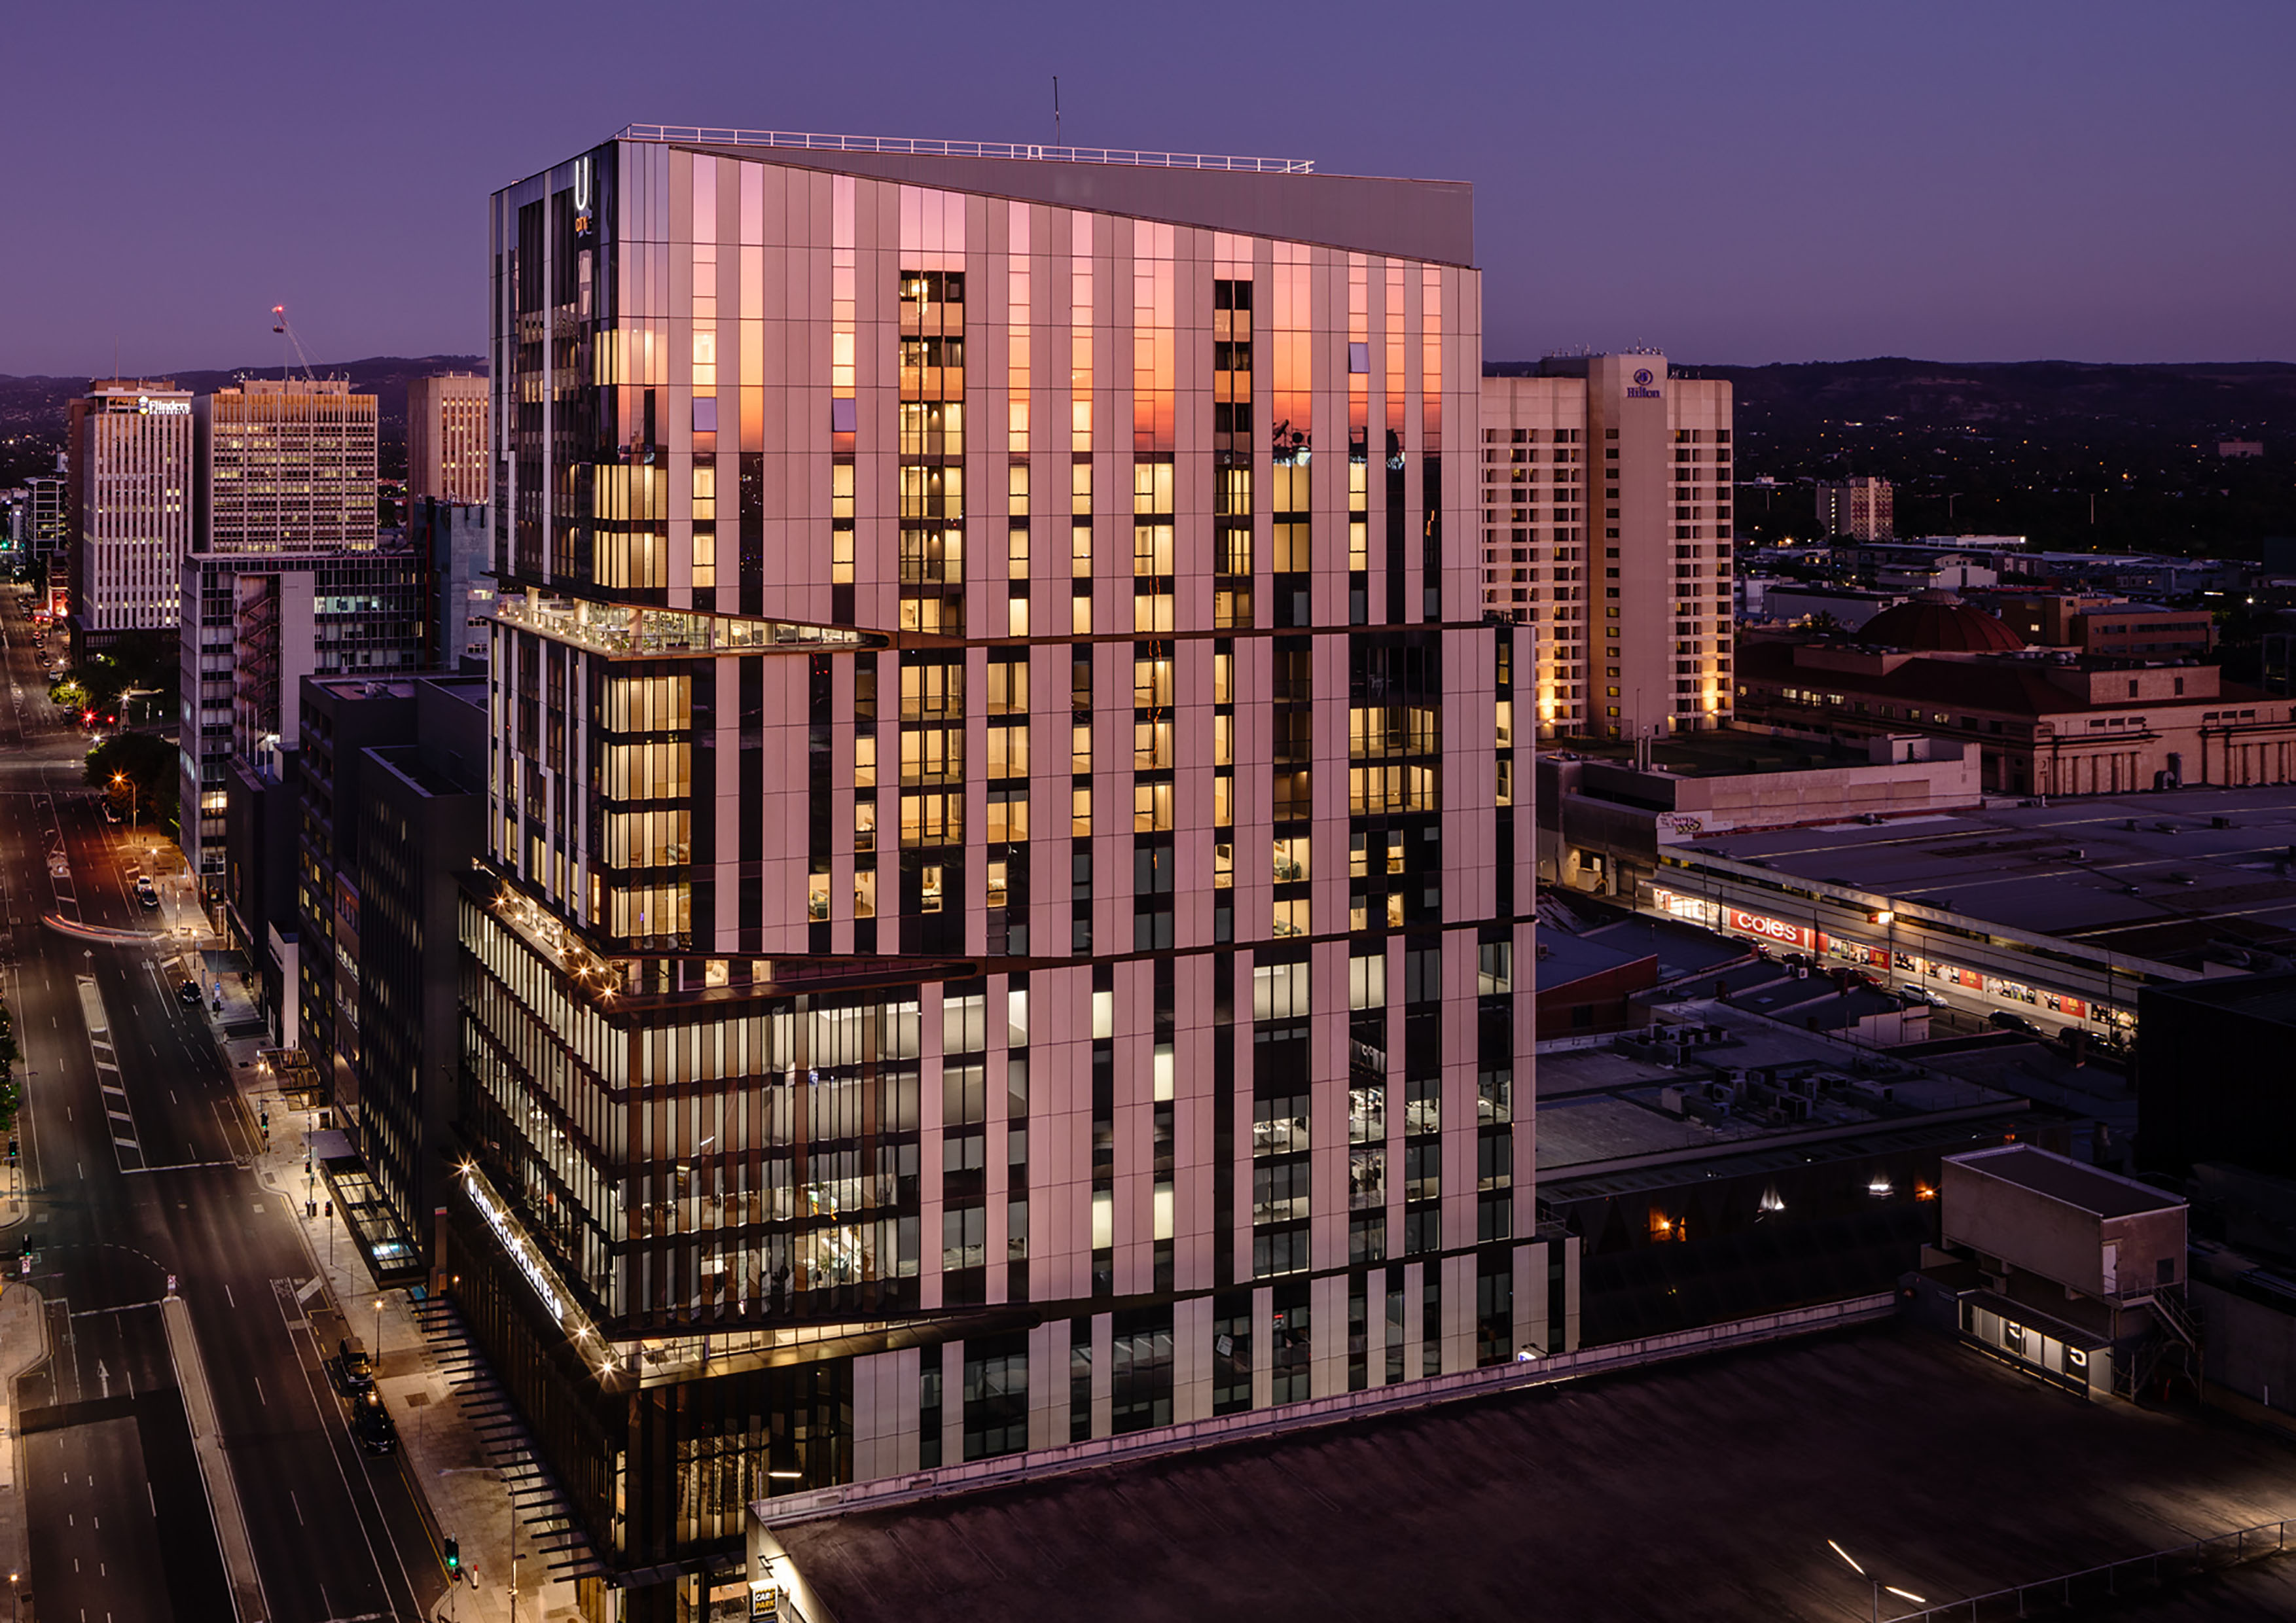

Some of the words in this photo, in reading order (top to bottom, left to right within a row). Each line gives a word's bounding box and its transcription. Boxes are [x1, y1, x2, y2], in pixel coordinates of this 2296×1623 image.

[575, 156, 588, 211] U
[1627, 386, 1660, 398] Hilton
[149, 400, 190, 410] Flinders
[1738, 913, 1797, 940] coles
